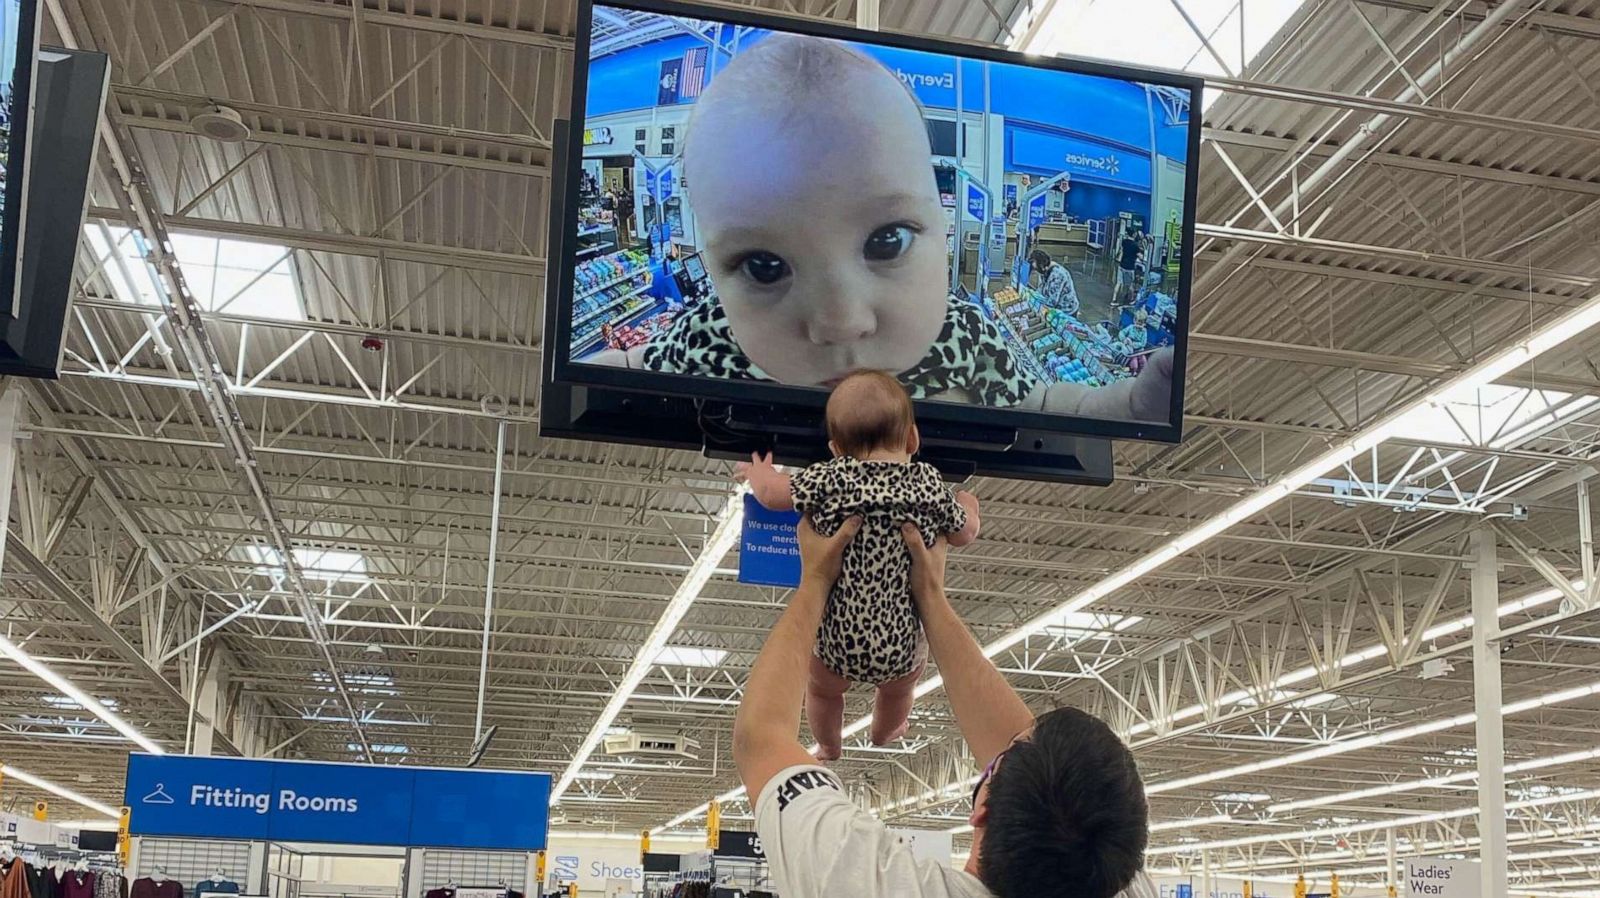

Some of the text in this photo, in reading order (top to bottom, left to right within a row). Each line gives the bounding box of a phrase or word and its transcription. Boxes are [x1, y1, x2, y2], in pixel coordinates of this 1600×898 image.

[748, 520, 762, 529] We
[763, 523, 778, 531] use
[746, 543, 756, 552] To
[758, 544, 788, 554] reduce
[190, 785, 358, 814] Fitting Rooms
[591, 861, 641, 878] Shoes
[1410, 864, 1453, 879] Ladies'
[1410, 880, 1444, 895] Wear
